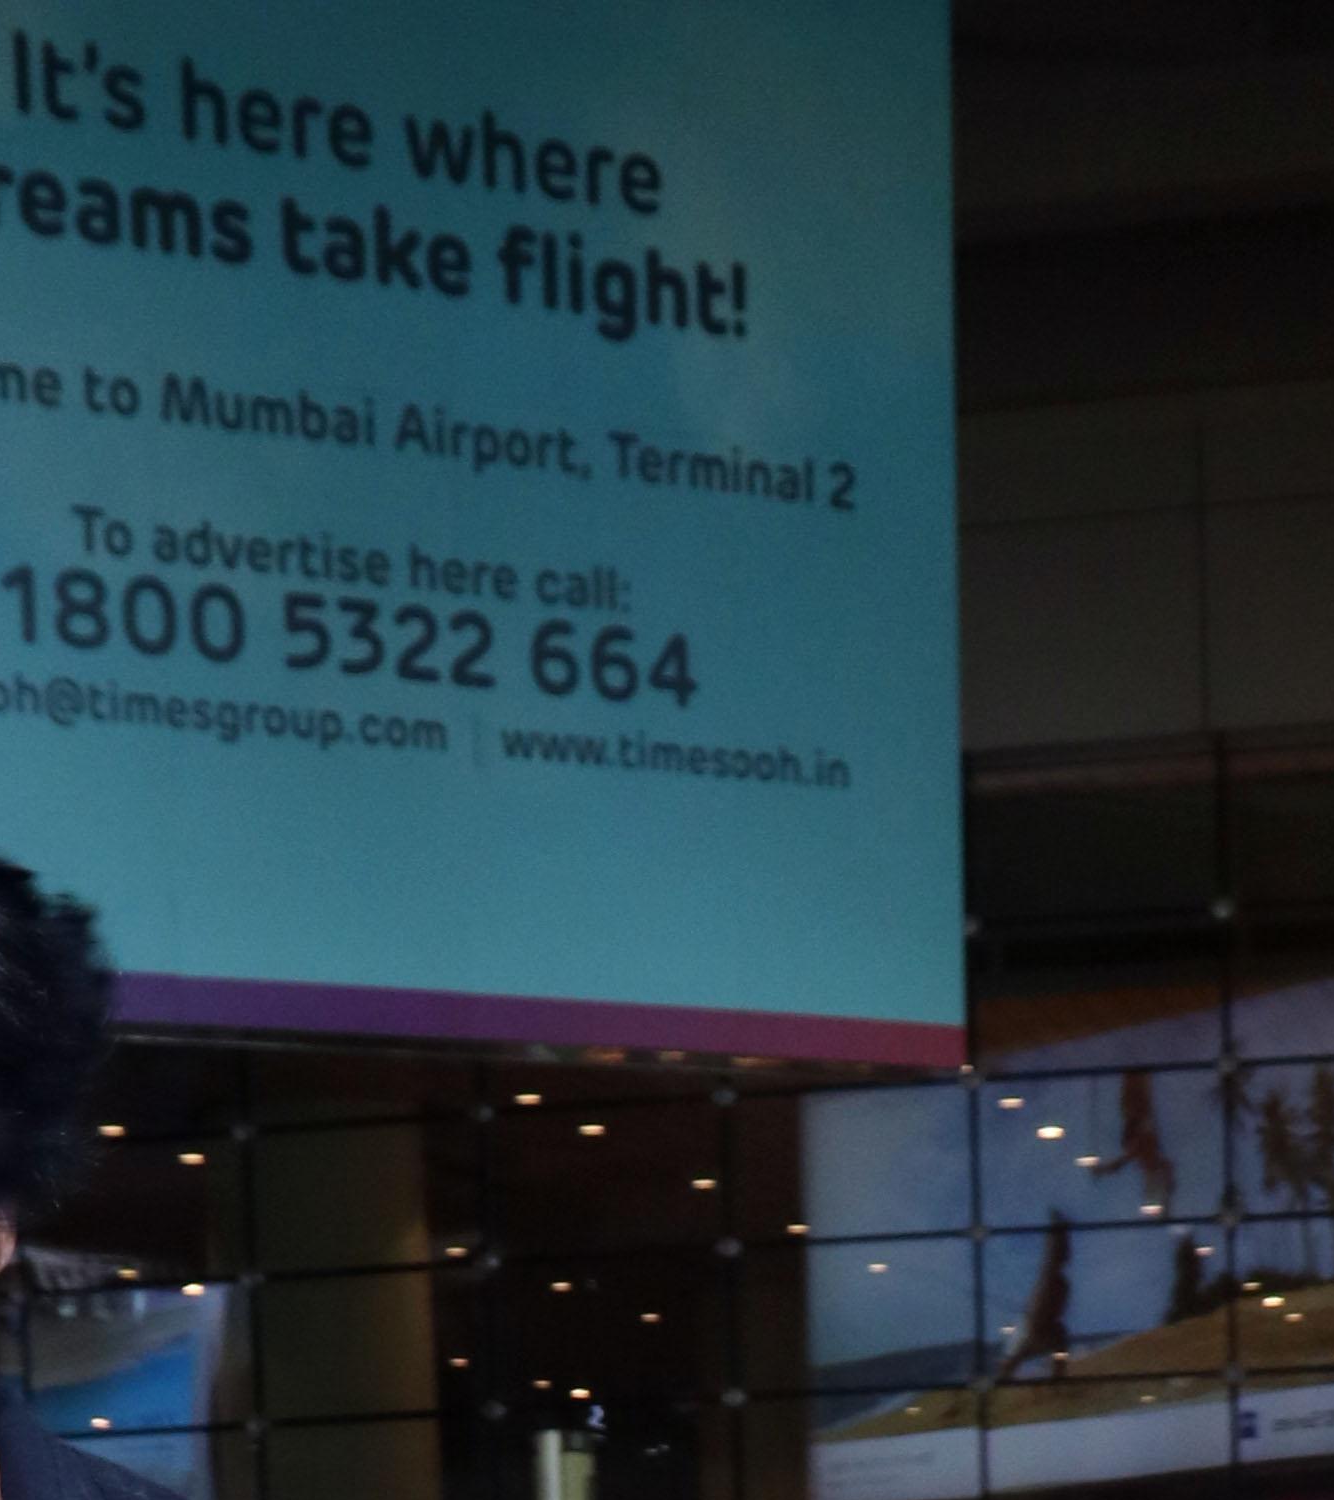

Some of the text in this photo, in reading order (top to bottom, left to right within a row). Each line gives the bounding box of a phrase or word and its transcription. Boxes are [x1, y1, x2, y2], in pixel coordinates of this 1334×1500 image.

[13, 27, 661, 214] It's here where
[280, 197, 471, 295] take
[497, 224, 746, 341] flight!
[83, 366, 141, 416] to
[161, 372, 377, 448] Mumbai
[608, 430, 815, 503] Terminal
[826, 460, 855, 510] 2
[72, 504, 631, 613] To advertise here call:
[0, 564, 697, 707] 1800 5322 664
[501, 725, 853, 789] www.timesooh.in
